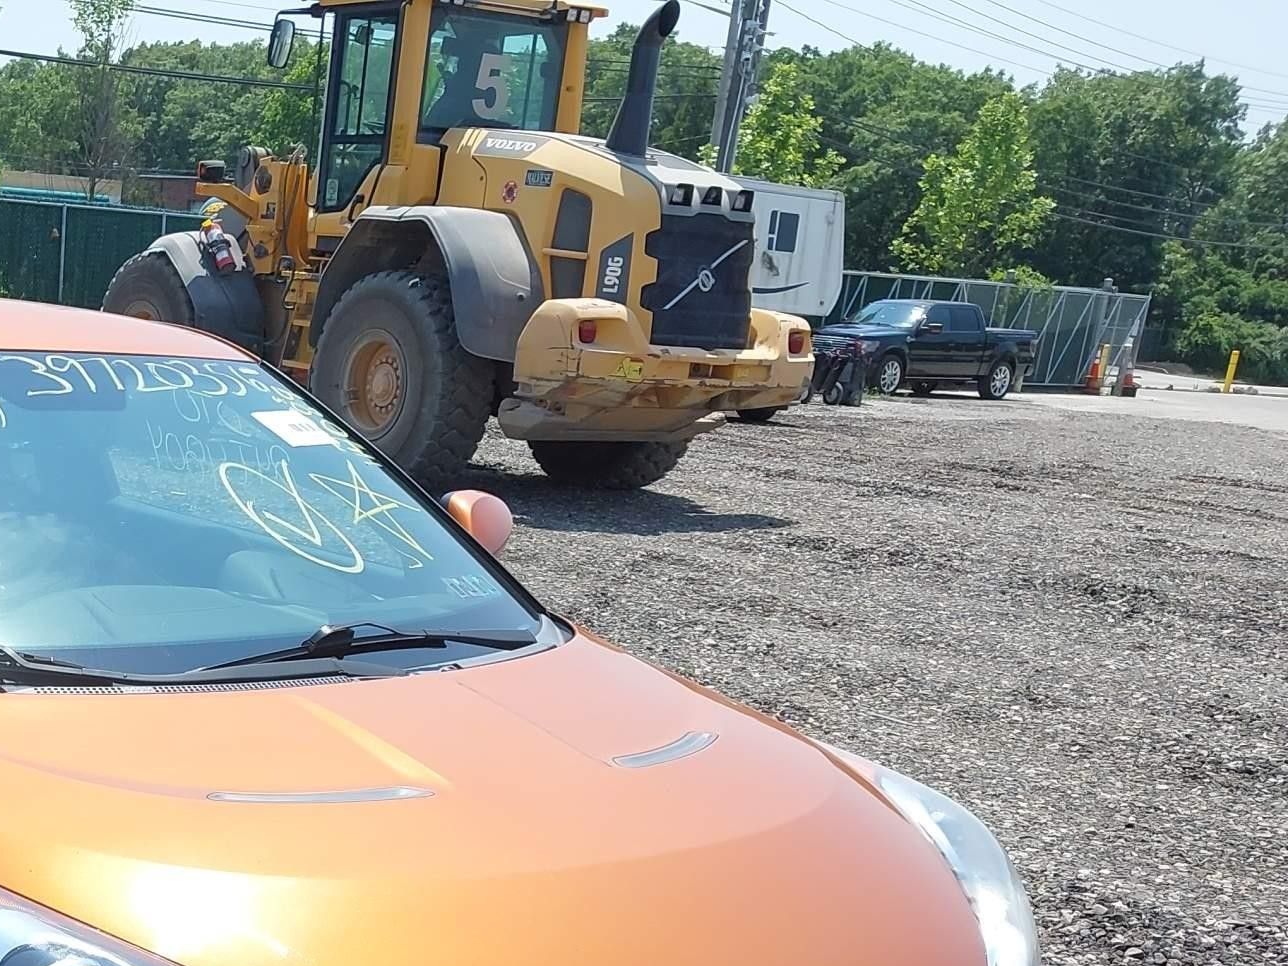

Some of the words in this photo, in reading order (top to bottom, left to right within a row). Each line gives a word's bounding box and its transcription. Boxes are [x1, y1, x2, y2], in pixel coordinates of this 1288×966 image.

[472, 53, 502, 120] 5
[486, 137, 537, 151] VOLVO
[602, 256, 624, 293] L90G
